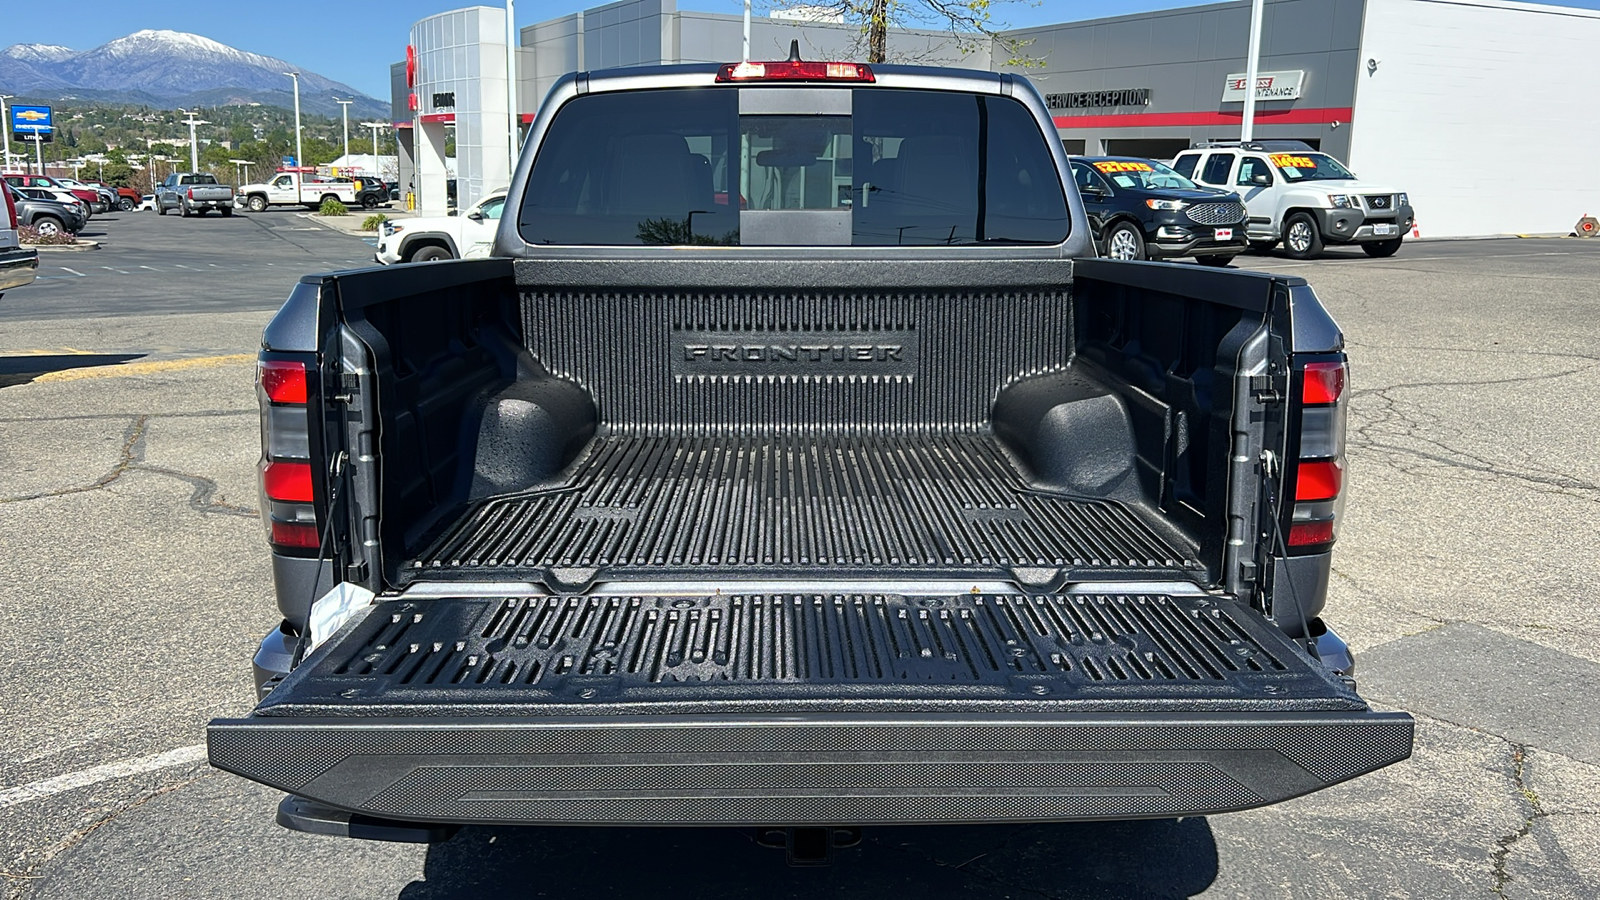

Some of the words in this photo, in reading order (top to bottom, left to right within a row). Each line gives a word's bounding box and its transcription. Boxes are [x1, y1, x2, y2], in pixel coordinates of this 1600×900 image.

[1238, 79, 1270, 89] EESS
[1044, 93, 1084, 109] SERVICE
[1085, 88, 1149, 107] RECEPTION
[684, 345, 902, 362] FRONTIER
